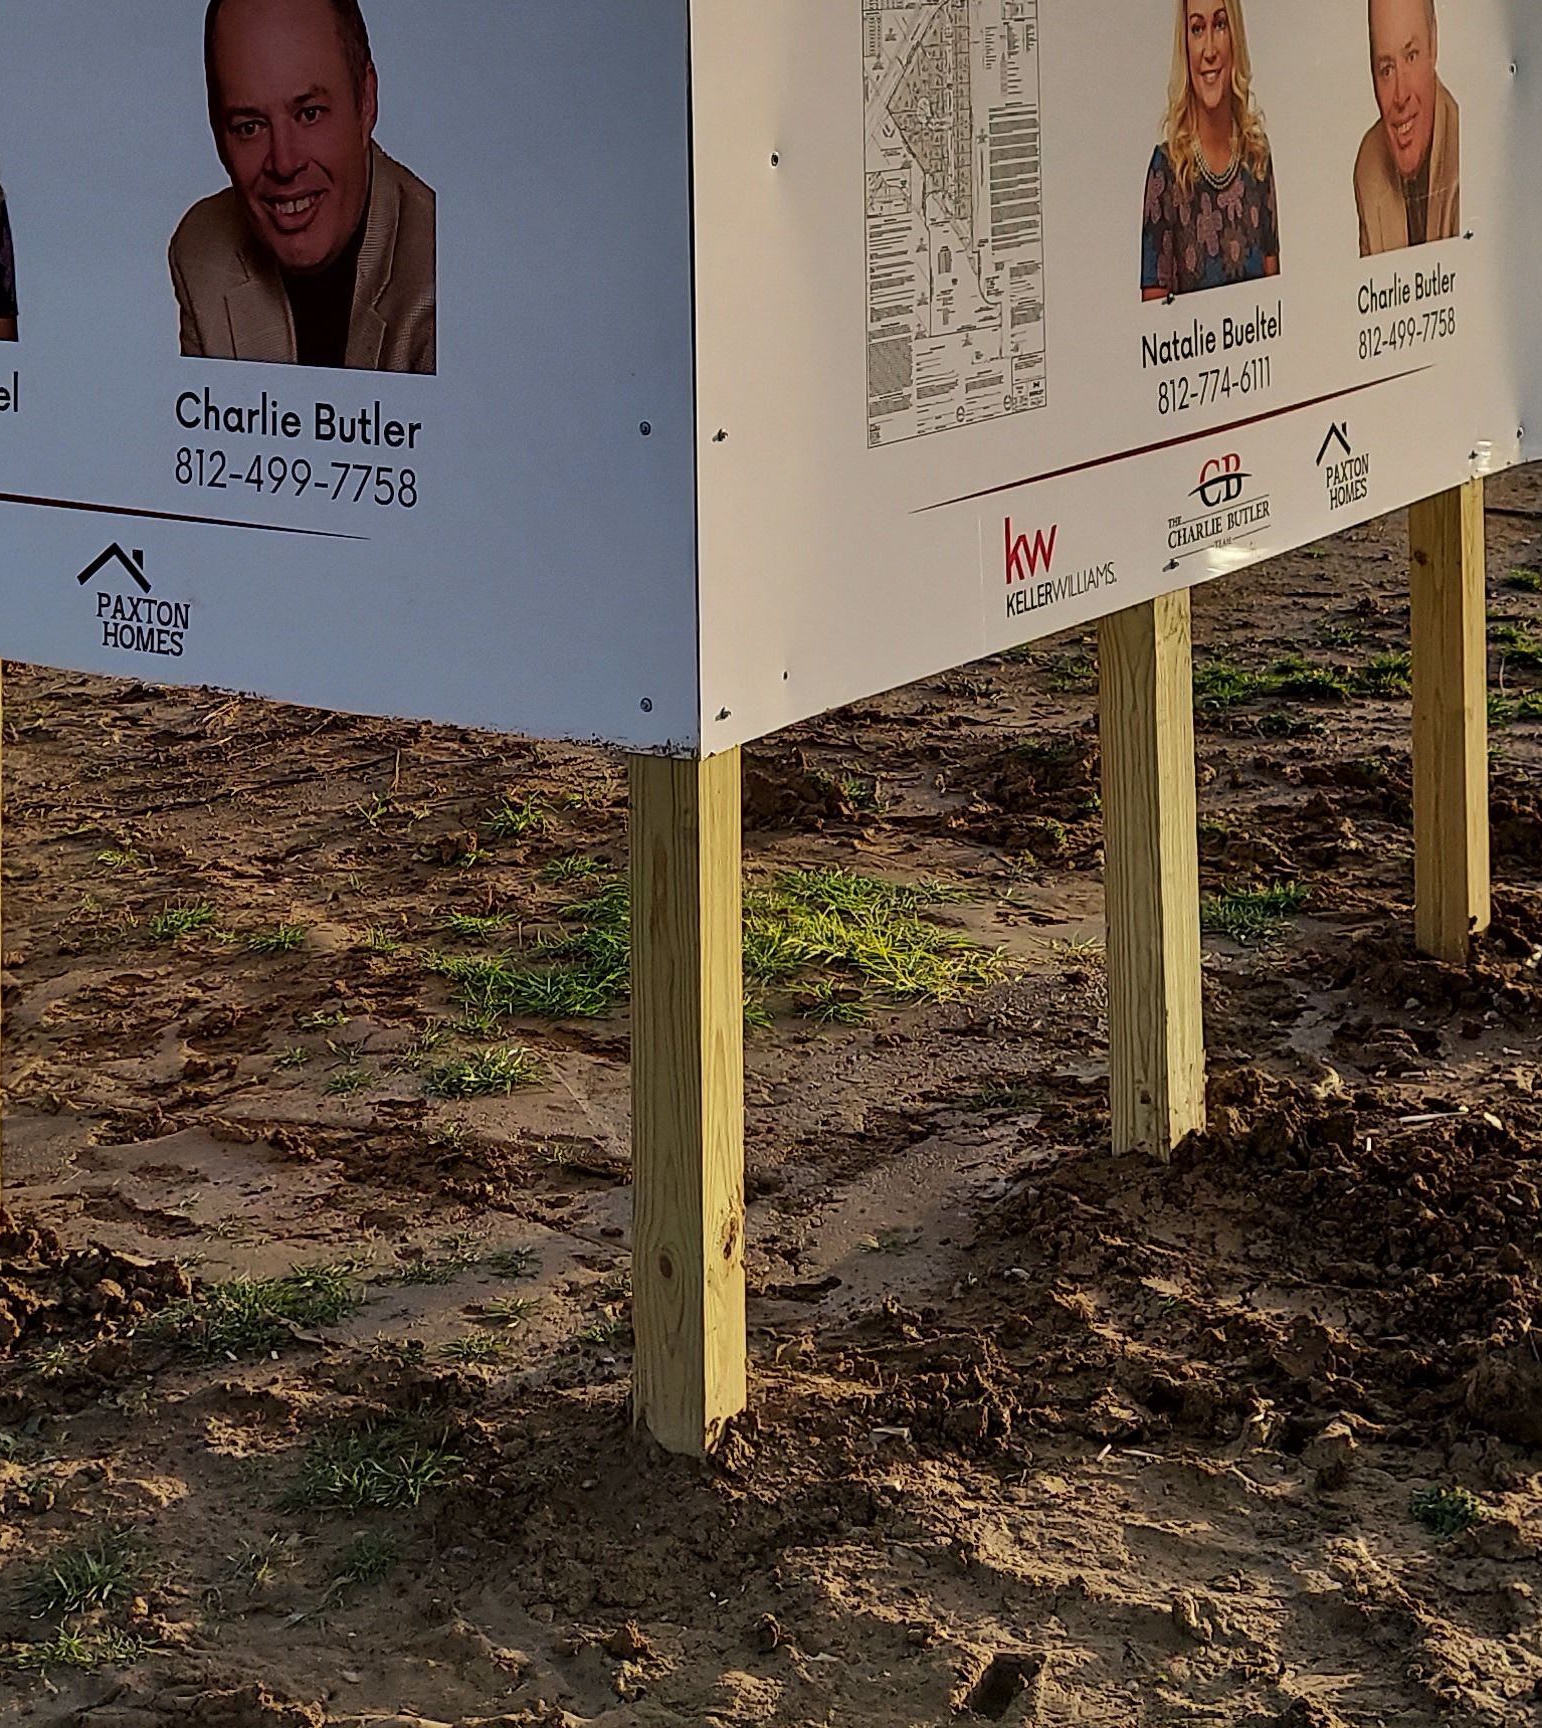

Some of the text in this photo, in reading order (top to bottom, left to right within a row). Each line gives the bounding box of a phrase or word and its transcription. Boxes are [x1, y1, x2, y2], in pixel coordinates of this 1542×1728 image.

[1357, 262, 1455, 315] Charlie Butler
[1141, 301, 1282, 368] Natalie Bueltel
[1358, 306, 1455, 360] 812-499-7758
[1158, 356, 1271, 415] 812-774-6111
[175, 388, 422, 449] Charlie Butler
[174, 448, 418, 509] 812-499-7758
[1200, 453, 1242, 507] CB
[1325, 453, 1370, 487] PAXTON
[1329, 479, 1368, 511] HOMES
[1168, 516, 1182, 528] THE
[1168, 501, 1270, 548] CHARLIE BUTLER
[97, 591, 190, 630] PAXTON
[101, 621, 184, 657] HOMES
